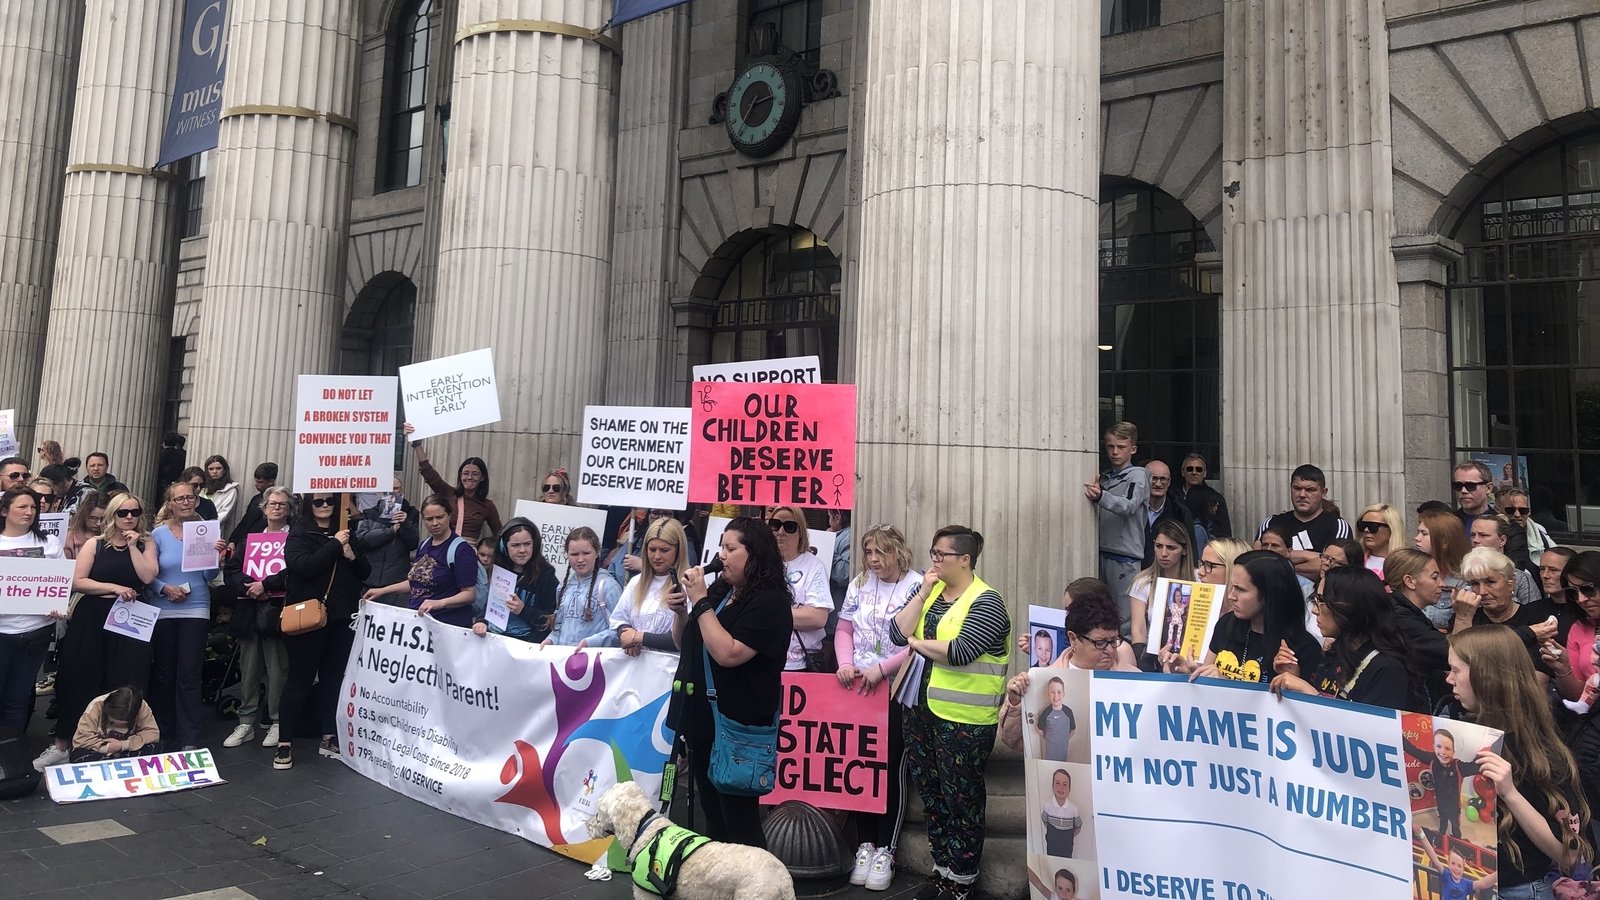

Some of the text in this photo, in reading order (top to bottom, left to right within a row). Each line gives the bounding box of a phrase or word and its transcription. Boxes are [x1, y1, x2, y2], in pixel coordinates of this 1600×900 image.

[180, 80, 225, 113] mus
[176, 108, 217, 135] WITNESS
[430, 373, 464, 388] EARLY
[732, 367, 817, 384] SUPPORT
[323, 388, 373, 400] DO NOT LET
[406, 377, 492, 403] INTERVENTION
[436, 392, 463, 405] ISN'T
[304, 411, 389, 423] A BROKEN SYSTEM
[434, 400, 467, 416] EARLY
[744, 393, 800, 418] OUR
[590, 417, 689, 435] SHAME ON THE
[702, 418, 818, 443] CHILDREN
[299, 432, 392, 444] CONVINCE YOU THAT
[591, 436, 683, 454] GOVERNMENT
[319, 455, 371, 467] YOU HAVE A
[586, 454, 685, 474] OUR CHILDREN
[730, 445, 833, 471] DESERVE
[310, 477, 377, 489] BROKEN CHILD
[582, 472, 685, 494] DESERVE MORE
[717, 473, 828, 505] BETTER
[541, 523, 575, 535] EARLY
[249, 541, 286, 557] 79%
[544, 554, 569, 565] ARLY
[6, 575, 71, 584] accountability
[246, 558, 287, 578] NO
[6, 585, 32, 597] the
[36, 586, 69, 598] HSE
[364, 614, 386, 642] The
[360, 686, 429, 719] No Accountability
[445, 672, 499, 711] Parent!
[358, 707, 376, 721] €3.5
[378, 714, 389, 724] on
[390, 716, 426, 739] Children's
[777, 719, 878, 758] STATE
[1095, 701, 1403, 789] MY NAME IS JUDE
[357, 727, 471, 779] €1.2m on Legal Costs since 2018
[1405, 760, 1421, 768] ude
[55, 750, 214, 786] LETS MAKE
[358, 746, 374, 762] 79%
[400, 766, 411, 780] NO
[412, 771, 443, 794] SERVICE
[778, 757, 887, 798] GLECT
[78, 769, 213, 799] A FUSS
[1096, 754, 1408, 841] I'M NOT JUST A NUMBER
[1103, 867, 1110, 889] I
[1116, 869, 1215, 900] DESERVE
[1223, 881, 1251, 900] TO
